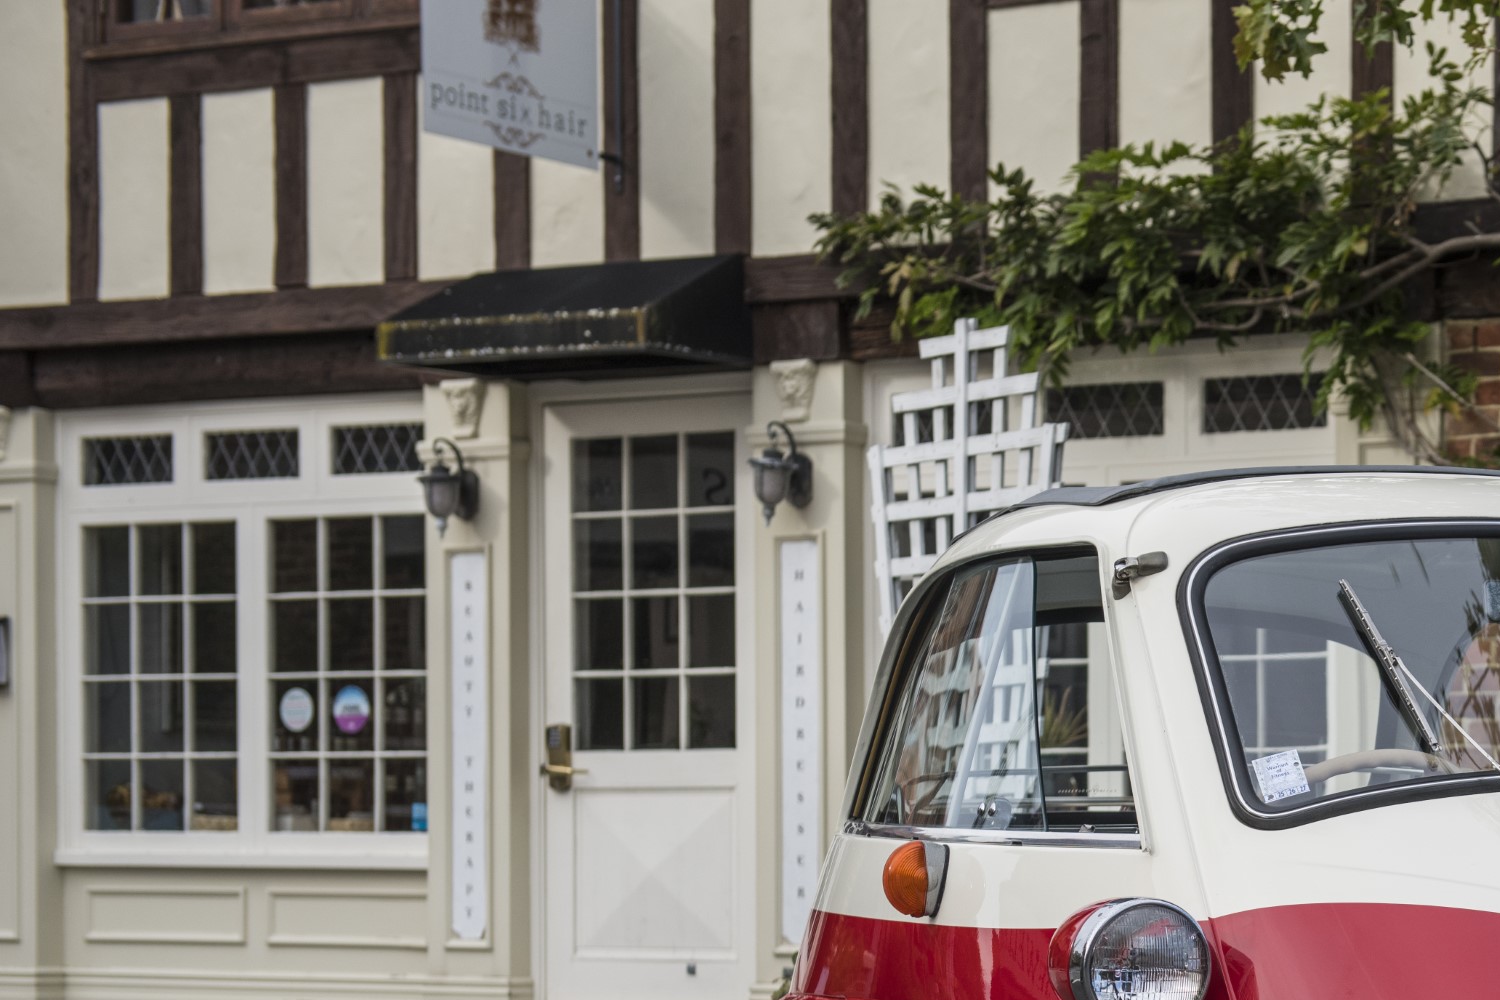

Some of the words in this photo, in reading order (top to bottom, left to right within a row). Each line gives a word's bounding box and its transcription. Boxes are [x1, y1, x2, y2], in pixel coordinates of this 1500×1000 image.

[430, 82, 489, 115] point
[496, 96, 533, 125] six
[538, 102, 588, 137] hair
[464, 579, 474, 719] BEAUTY
[794, 569, 806, 899] HAIRDRESSER
[464, 755, 475, 919] THERAPY
